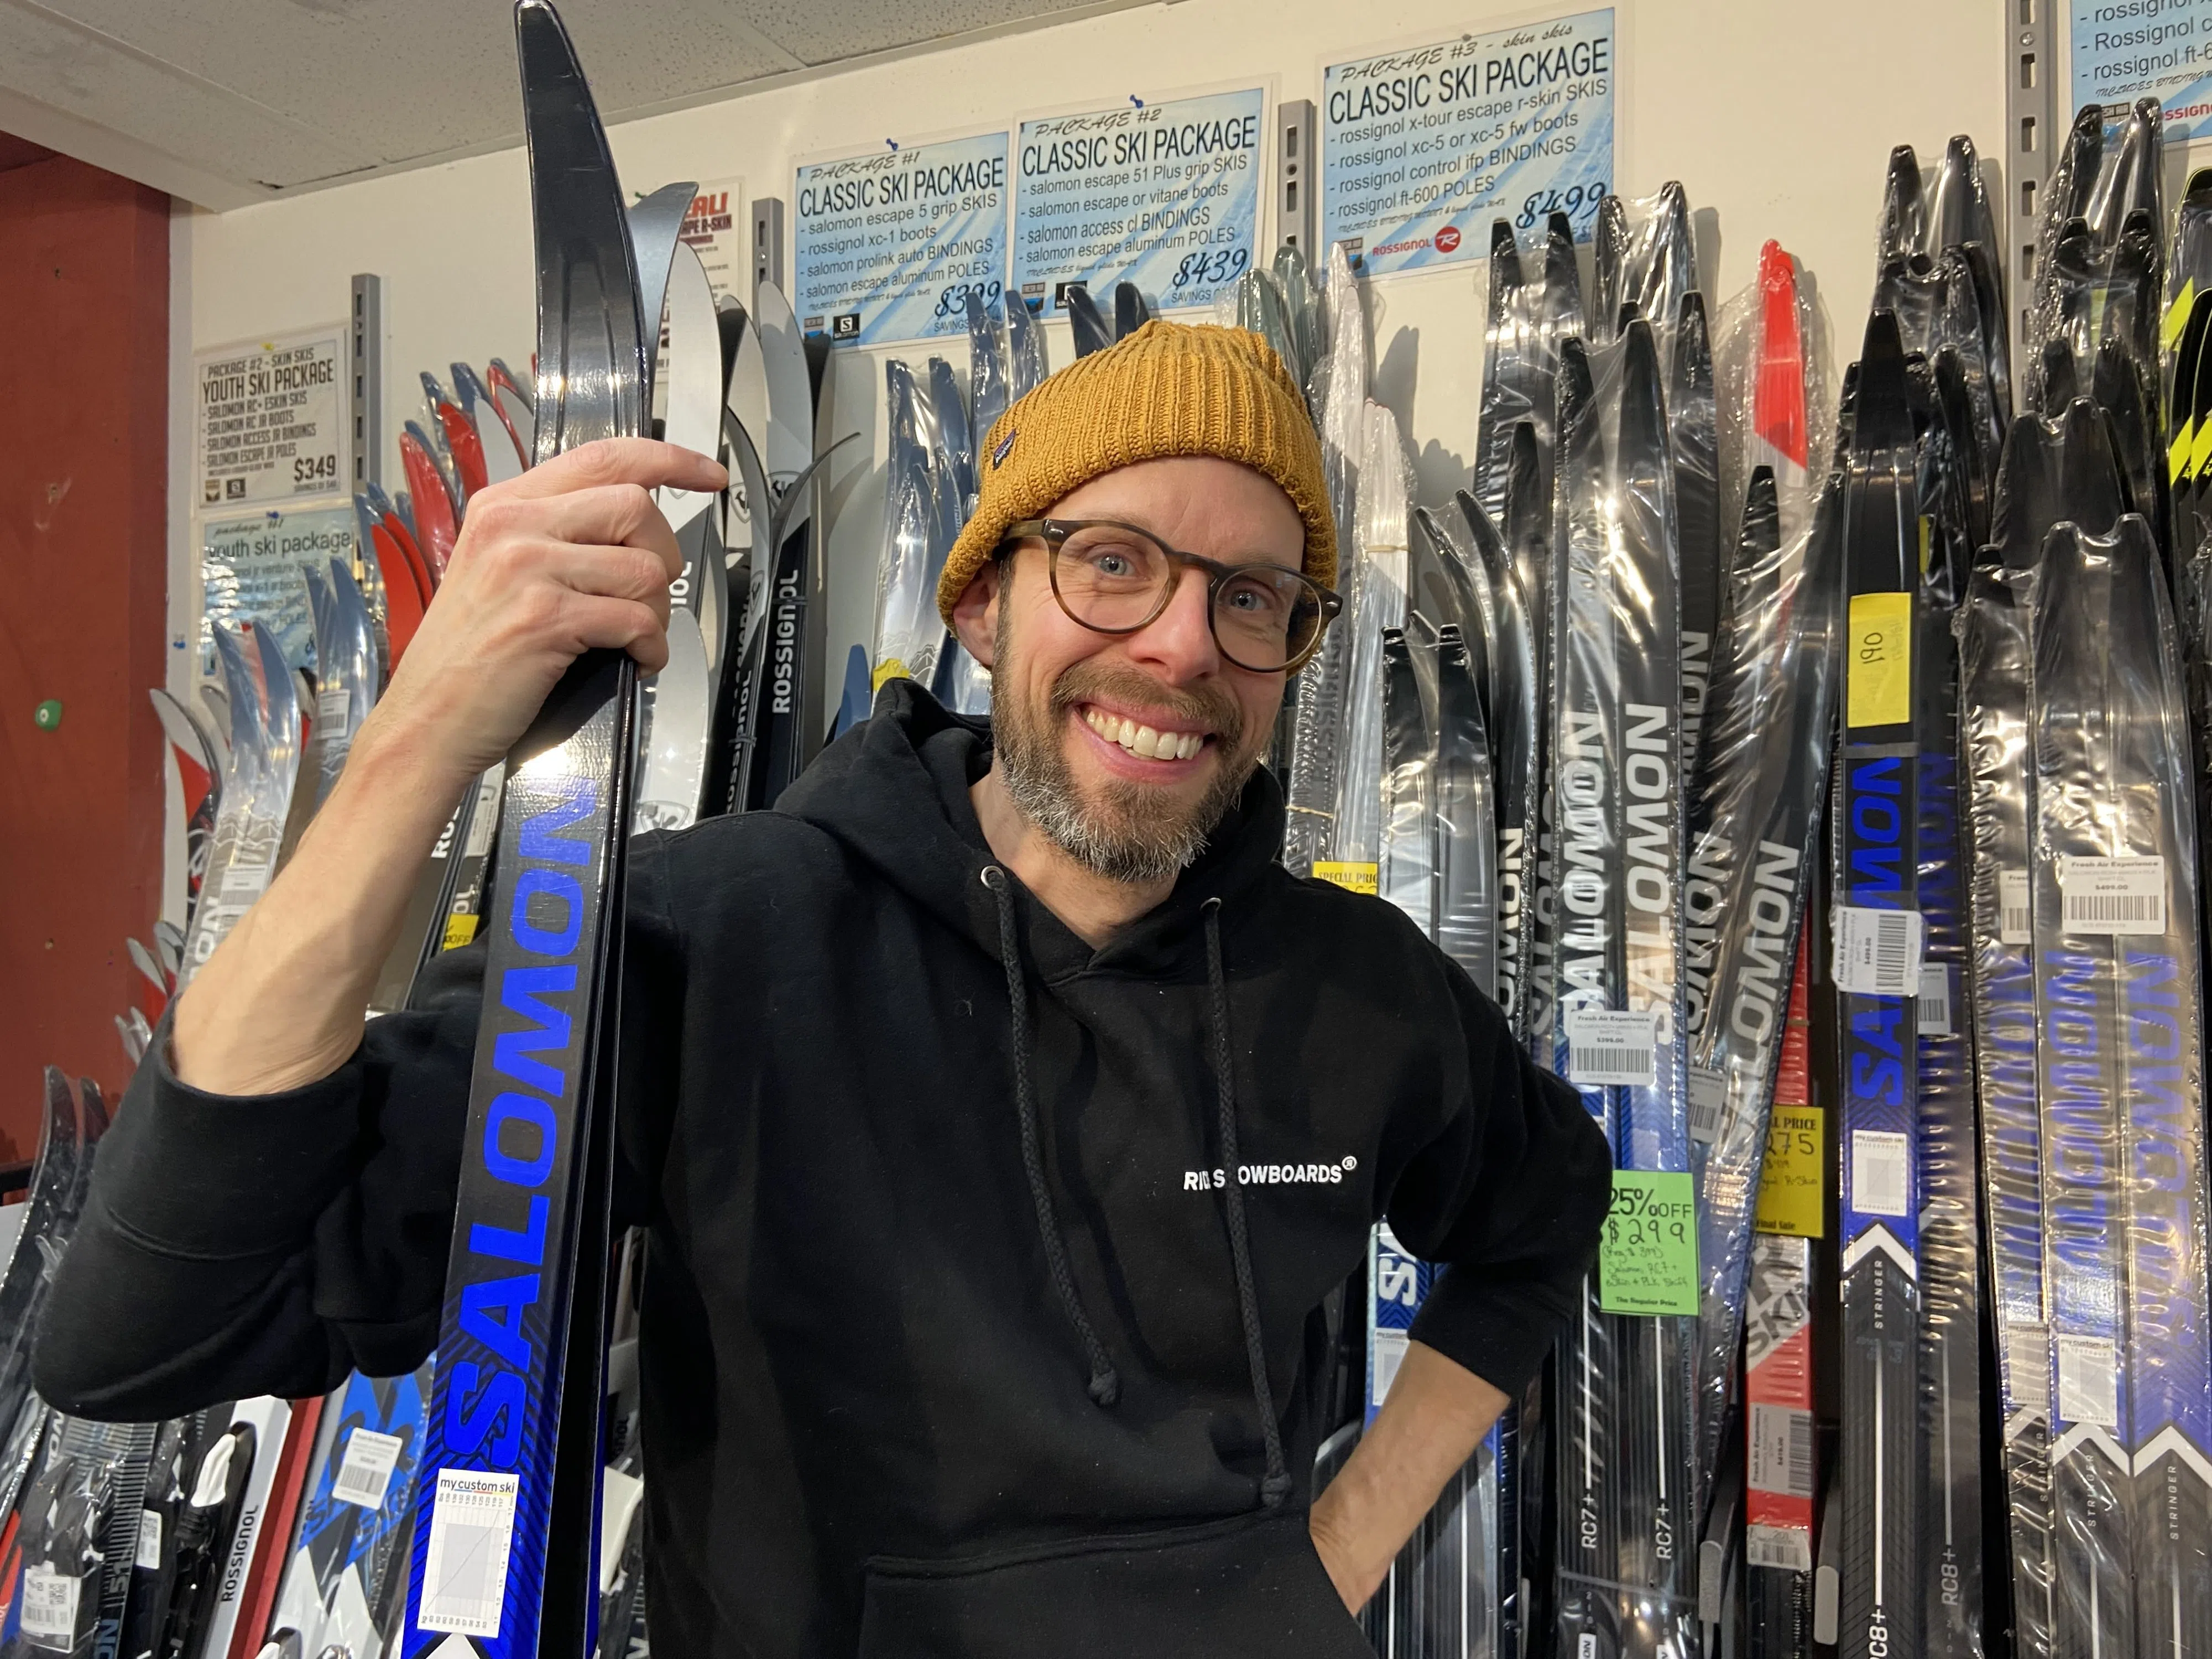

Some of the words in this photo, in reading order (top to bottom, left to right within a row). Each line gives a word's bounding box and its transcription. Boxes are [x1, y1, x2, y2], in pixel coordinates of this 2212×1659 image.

[2095, 0, 2192, 22] rossigno
[2095, 16, 2194, 51] Rossignol
[1341, 48, 1444, 83] PACKAGE
[1449, 41, 1479, 60] #3
[1502, 32, 1535, 49] skin
[1542, 23, 1573, 41] skis
[2095, 48, 2177, 80] rossignol
[1330, 74, 1431, 124] CLASSIC
[1438, 65, 1478, 103] SKI
[1486, 38, 1608, 95] PACKAGE
[2096, 80, 2153, 97] INCLUDES
[1035, 111, 1131, 138] PACKAGE
[1138, 108, 1161, 123] #2
[1339, 121, 1405, 147] rossignol
[1409, 111, 1452, 132] x-tour
[1457, 101, 1513, 124] escape
[1517, 90, 1561, 111] r-skin
[1566, 79, 1608, 100] SKIS
[1022, 137, 1108, 176] CLASSIC
[1114, 132, 1146, 165] SKI
[1154, 116, 1255, 160] PACKAGE
[1339, 145, 1407, 171] rossignol
[1411, 135, 1444, 155] xc-5
[1450, 134, 1465, 148] or
[1470, 124, 1504, 144] xc-5
[1510, 121, 1527, 137] fw
[1533, 113, 1579, 133] boots
[810, 155, 896, 181] PACKAGE
[902, 152, 920, 165] #1
[1030, 178, 1081, 196] salomon
[1085, 173, 1129, 190] escape
[1134, 168, 1148, 182] 51
[1154, 165, 1181, 180] Plus
[1185, 161, 1209, 180] grip
[1213, 155, 1248, 173] SKIS
[1339, 169, 1405, 196] rossignol
[1409, 158, 1462, 180] control
[1465, 150, 1485, 173] ifp
[1490, 136, 1576, 165] BINDINGS
[800, 179, 874, 217] CLASSIC
[880, 173, 907, 204] SKI
[914, 157, 1003, 200] PACKAGE
[1029, 201, 1079, 218] salomon
[1083, 195, 1129, 214] escape
[1133, 195, 1145, 205] or
[1150, 190, 1188, 204] vitane
[1193, 182, 1228, 199] boots
[1338, 194, 1397, 220] rossignol
[1400, 185, 1439, 207] ft-600
[1443, 176, 1494, 200] POLES
[808, 218, 862, 235] salomon
[867, 210, 914, 226] escape
[919, 206, 927, 218] 5
[932, 199, 957, 219] grip
[962, 194, 997, 211] SKIS
[1516, 182, 1605, 230] $499
[808, 236, 864, 255] rossignol
[869, 230, 895, 245] xc-1
[900, 226, 937, 241] boots
[1027, 223, 1077, 244] salomon
[1081, 220, 1123, 236] access
[1142, 207, 1209, 231] BINDINGS
[807, 261, 854, 277] salomon
[857, 254, 894, 271] prolink
[898, 249, 924, 263] auto
[927, 238, 993, 259] BINDINGS
[1026, 245, 1074, 263] salomon
[1078, 241, 1121, 259] escape
[1124, 234, 1185, 252] aluminum
[1188, 227, 1235, 247] POLES
[1373, 239, 1432, 255] ROSSIGNOL
[806, 283, 848, 298] salomon
[852, 276, 888, 294] escape
[891, 269, 945, 285] aluminum
[948, 261, 989, 279] POLES
[1172, 248, 1248, 289] $439
[1171, 290, 1211, 303] SAVINGS
[934, 319, 970, 331] SAVINGS
[202, 377, 244, 403] YOUTH
[249, 371, 270, 396] SKI
[275, 359, 333, 391] PACKAGE
[208, 362, 246, 378] PACKAGE
[250, 358, 262, 371] #2
[272, 352, 292, 368] SKIN
[294, 347, 314, 361] SKIS
[208, 400, 244, 420] SALOMON
[289, 391, 307, 405] SKIS
[208, 418, 243, 436] SALOMON
[269, 410, 294, 425] BOOTS
[207, 435, 241, 452] SALOMON
[207, 452, 238, 468] SALOMON
[294, 455, 336, 482] $349
[255, 535, 276, 556] ski
[282, 531, 350, 557] package
[773, 570, 798, 713] ROSSIGNOL
[1319, 872, 1353, 883] SPECIAL
[1498, 828, 1523, 1019] OMON
[444, 778, 596, 1468] SALOMON
[1784, 1117, 1816, 1130] PRICE
[1874, 1260, 1884, 1329] STRINGER
[440, 1479, 456, 1490] my
[458, 1481, 497, 1492] custom
[500, 1483, 515, 1493] ski
[2170, 1467, 2179, 1540] STRINGER
[221, 1505, 259, 1603] ROSSIGNOL
[1941, 1548, 1959, 1605] RC8+
[1869, 1609, 1887, 1659] C8+
